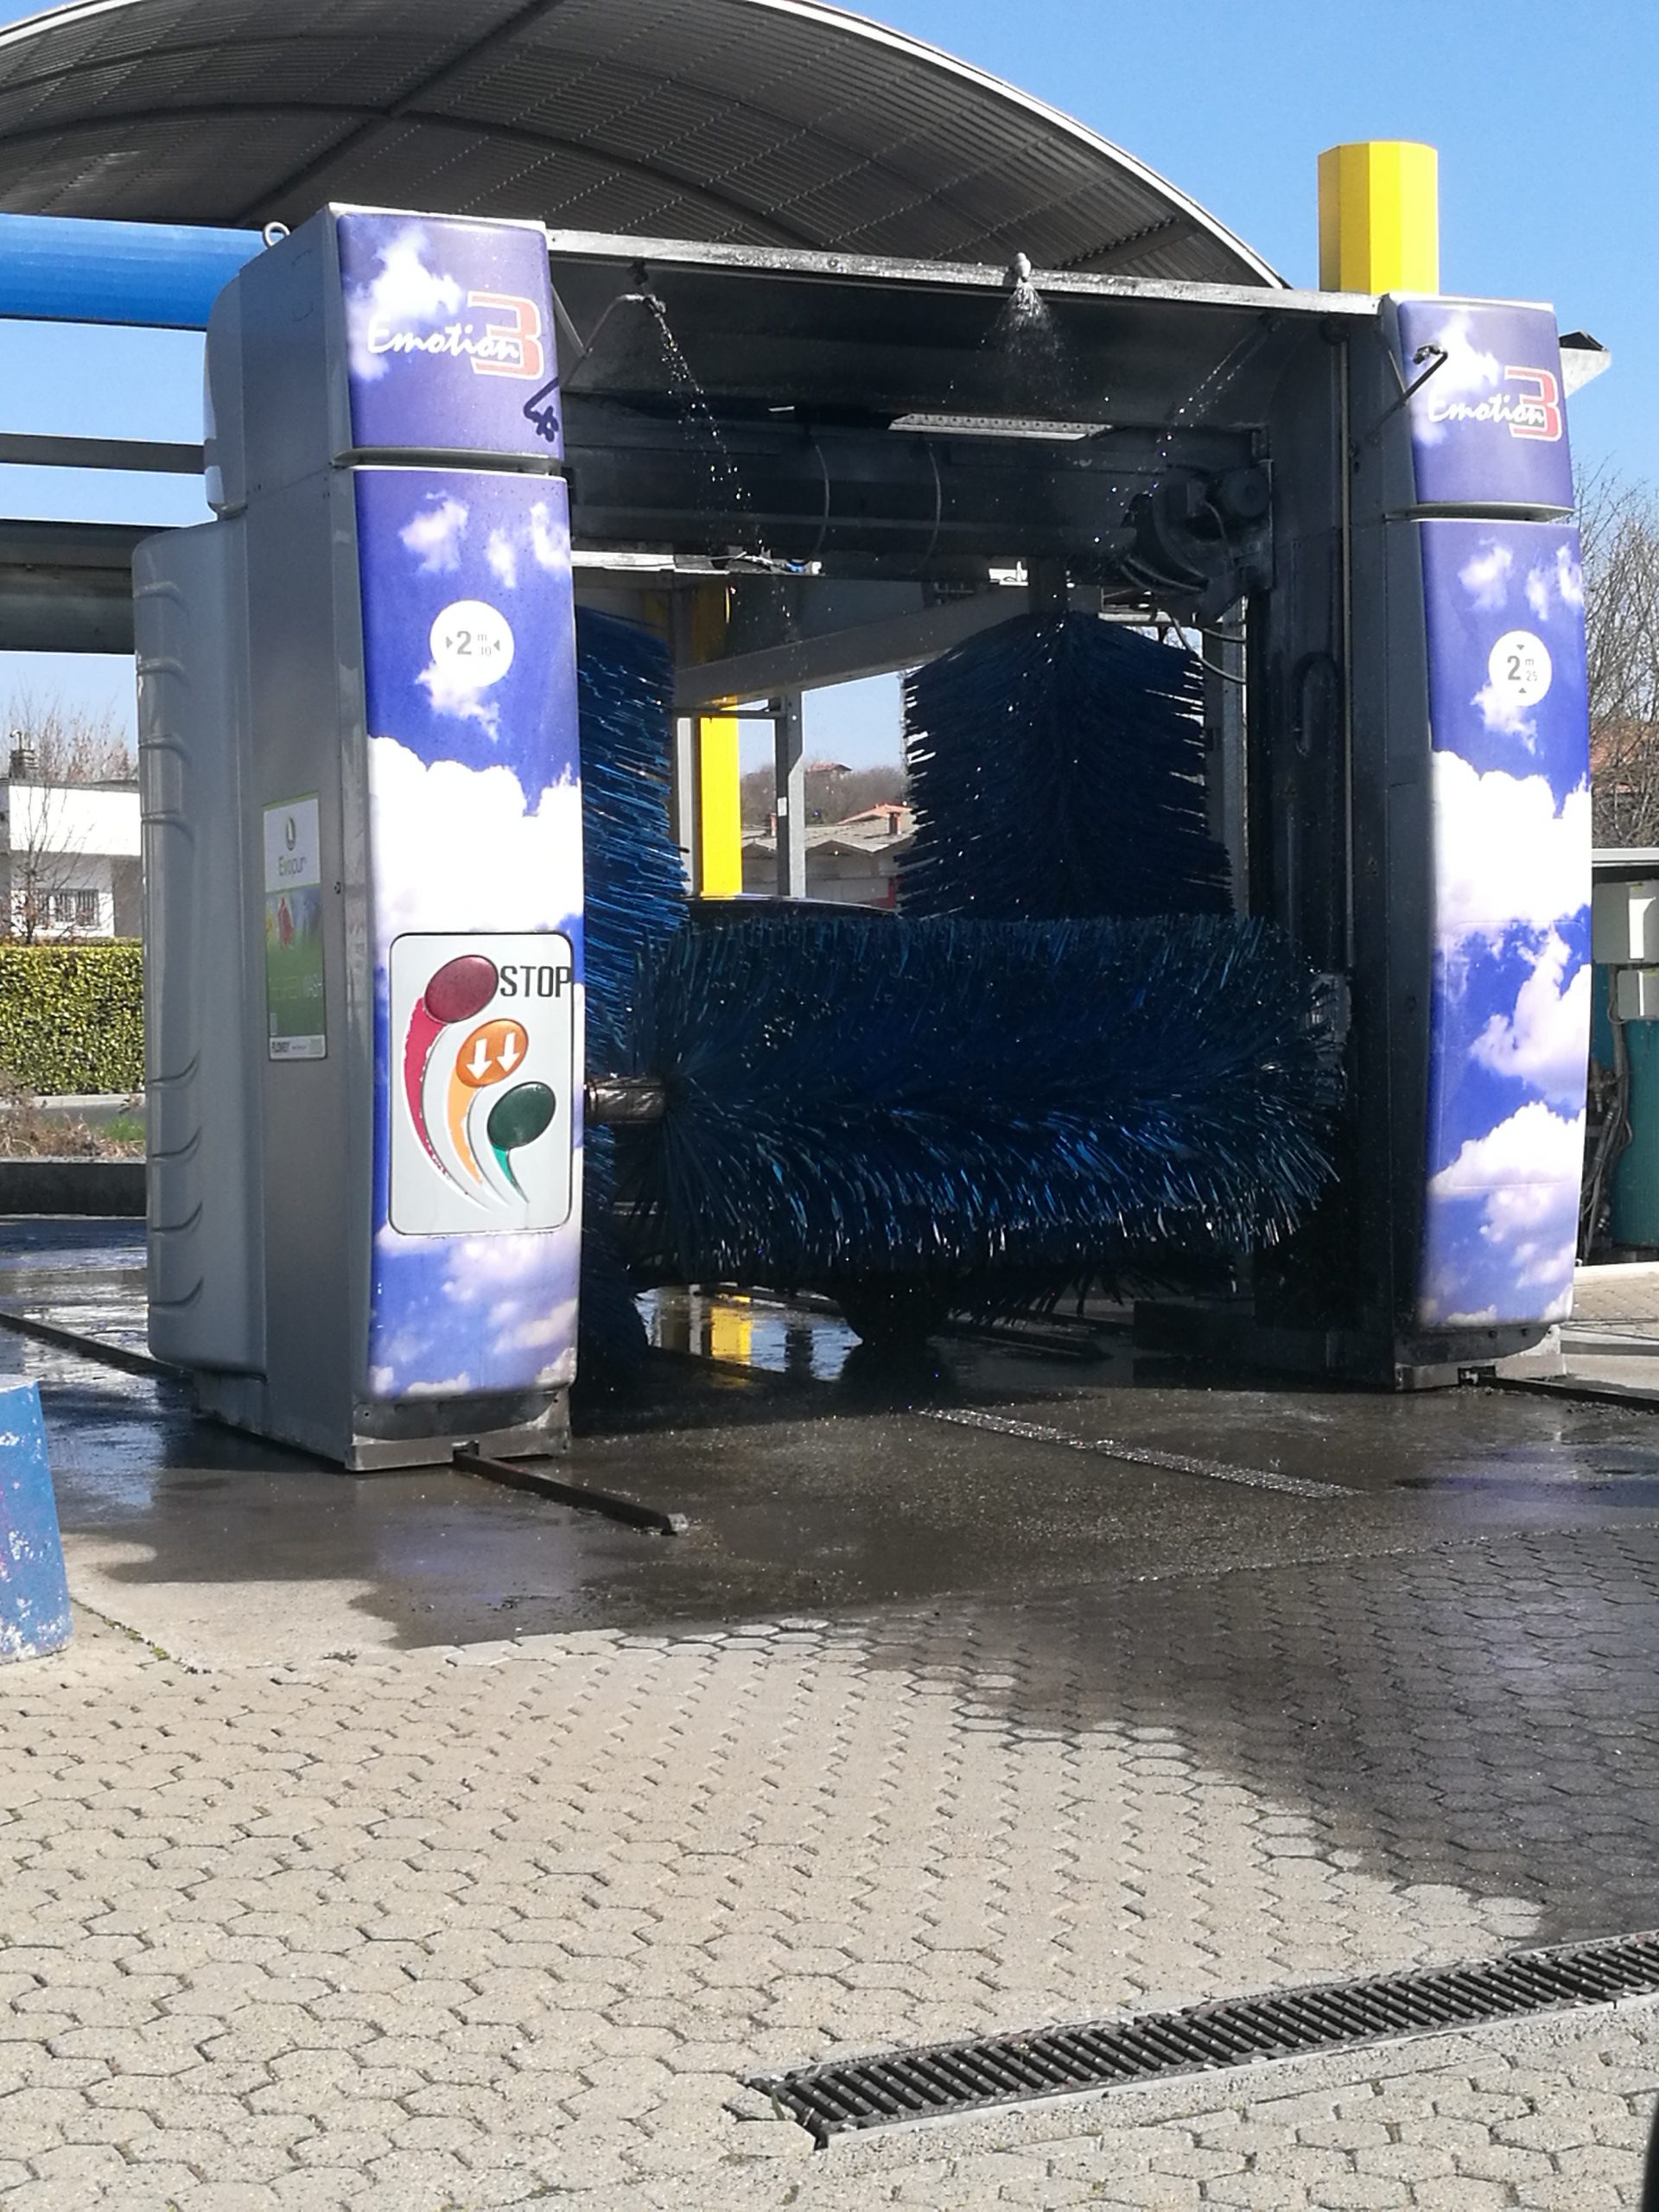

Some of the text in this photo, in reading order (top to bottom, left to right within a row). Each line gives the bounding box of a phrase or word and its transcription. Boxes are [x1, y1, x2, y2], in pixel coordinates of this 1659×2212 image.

[367, 290, 545, 380] Emotion 3
[1427, 365, 1562, 442] Emotion 3
[456, 630, 472, 655] 2
[1507, 655, 1522, 681] 2
[1526, 670, 1538, 682] 25
[499, 965, 572, 998] STOP
